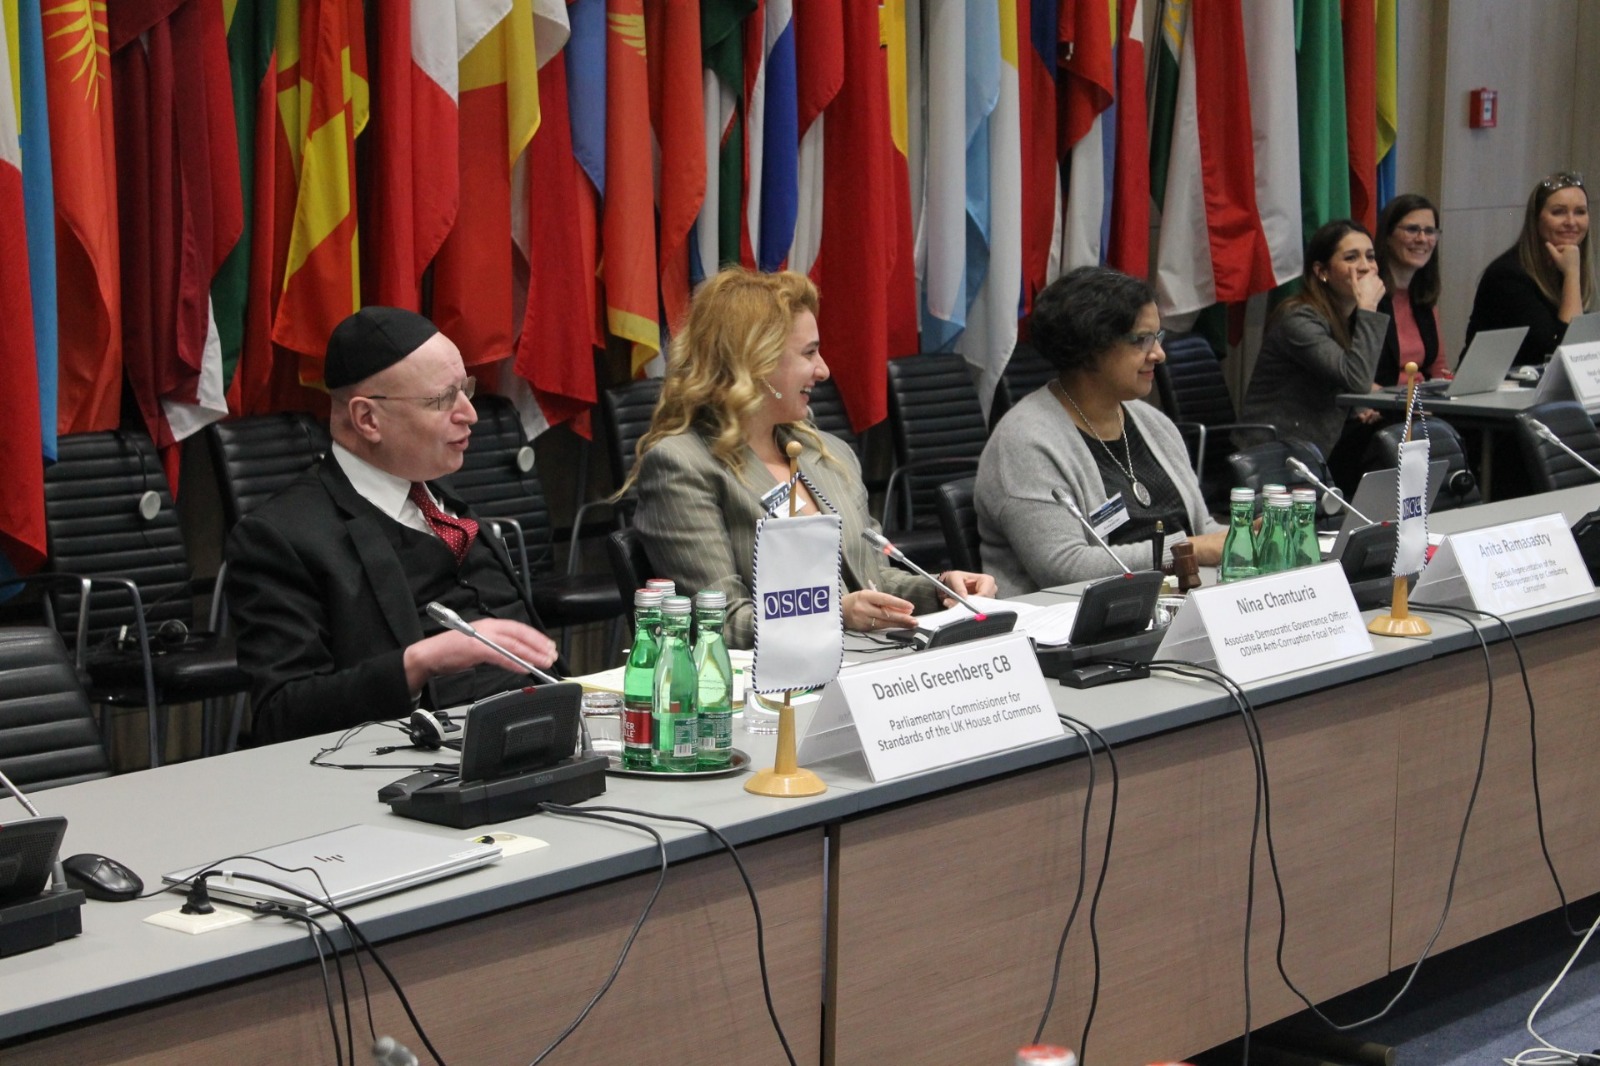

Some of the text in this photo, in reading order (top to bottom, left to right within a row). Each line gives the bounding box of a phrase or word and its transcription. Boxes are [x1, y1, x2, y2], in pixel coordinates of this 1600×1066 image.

[1479, 532, 1552, 557] Anita Ramasastry
[1236, 584, 1317, 615] Nina Chanturia
[1224, 633, 1255, 647] Associate
[1254, 624, 1292, 639] Democratic
[1292, 616, 1328, 630] Governance
[1239, 625, 1345, 657] ODIHR Anti-Corruption Focal Point
[872, 655, 1012, 701] Daniel Greenberg CB
[889, 691, 1021, 731] Parliamentary Commissioner for
[878, 704, 1042, 752] Standards of the UK House of Commons
